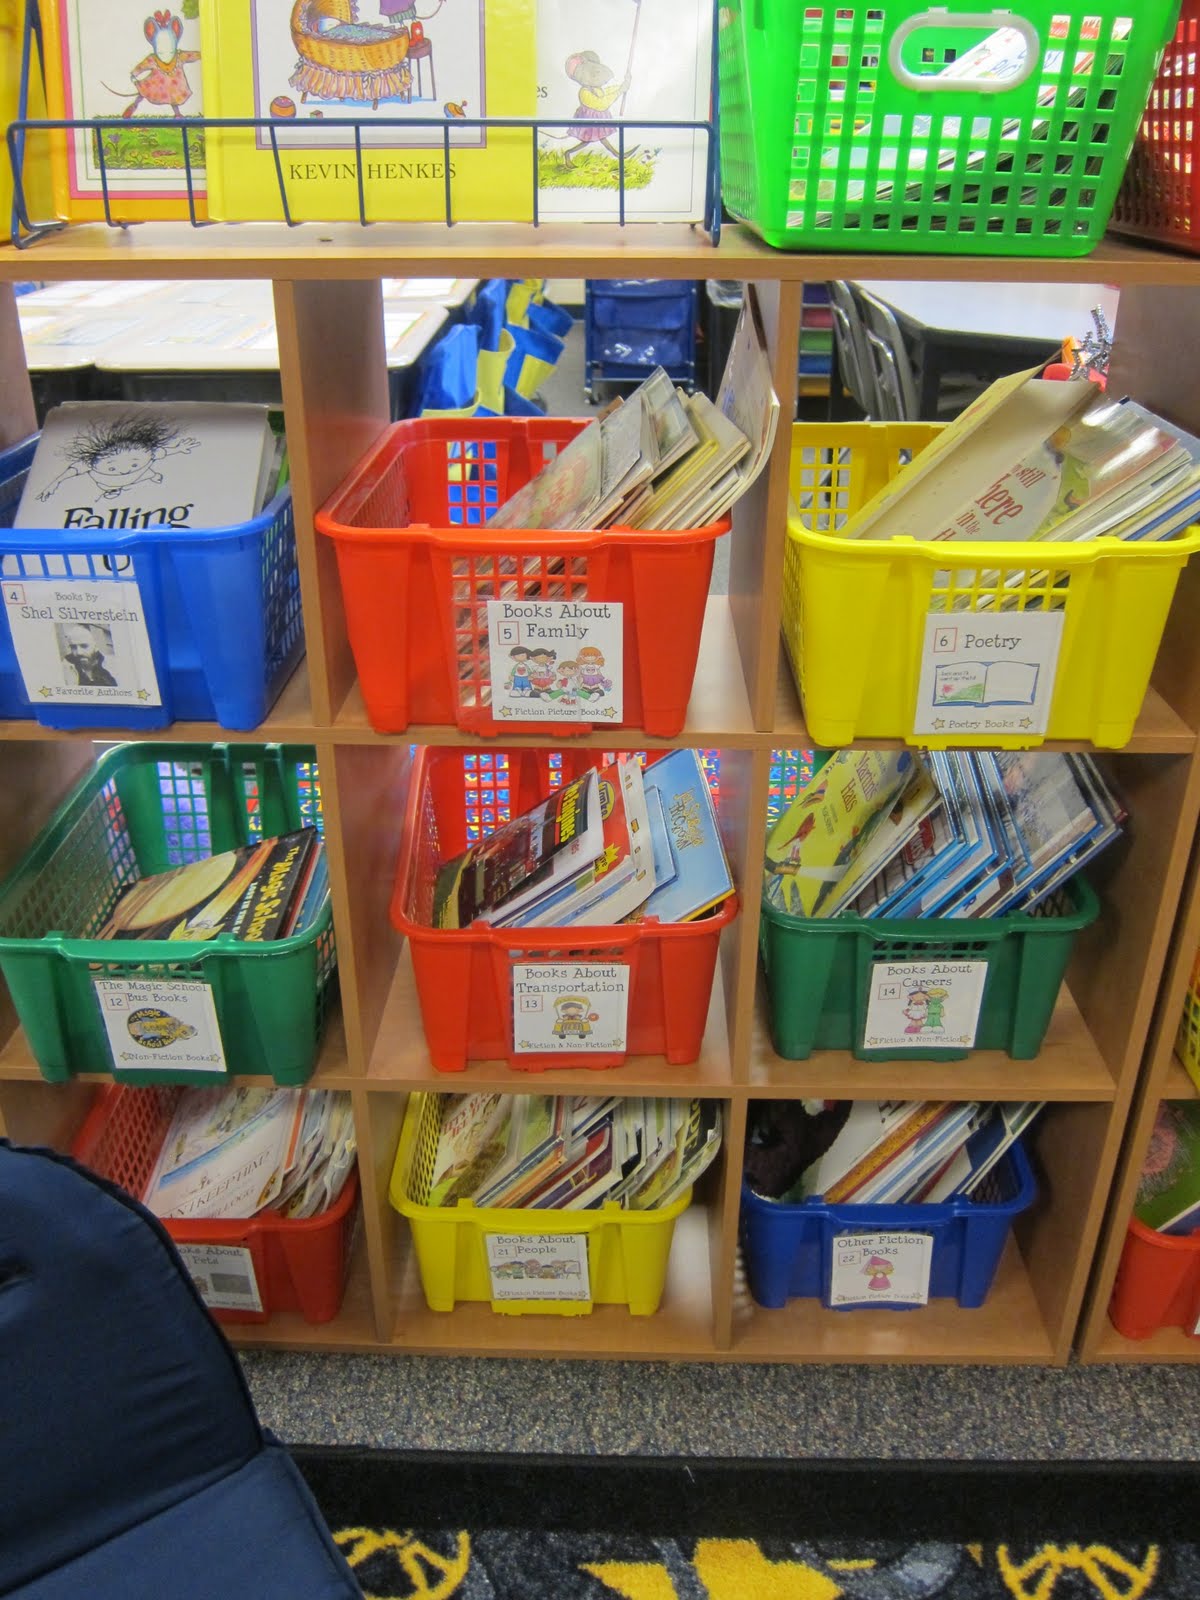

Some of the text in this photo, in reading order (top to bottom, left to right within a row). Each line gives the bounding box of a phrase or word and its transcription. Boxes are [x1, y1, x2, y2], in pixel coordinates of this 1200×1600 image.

[290, 163, 456, 180] KEVIN HENKES
[64, 503, 194, 529] Falling
[10, 591, 18, 602] 4
[54, 592, 99, 603] Books By
[21, 606, 139, 622] Shel Silverstein
[503, 604, 611, 619] Books About
[503, 624, 589, 640] 5 Family
[940, 634, 1021, 650] 6 Poetry
[55, 687, 133, 697] Favorite Authors
[515, 708, 606, 716] Fiction Picture Books
[948, 719, 1014, 729] Poetry Books
[841, 779, 858, 813] Hats
[285, 846, 300, 864] The
[259, 861, 291, 899] Magic
[525, 967, 617, 979] Books About
[887, 964, 972, 976] Books About
[100, 981, 208, 992] The Magic School
[516, 982, 625, 994] Transportation
[902, 978, 952, 988] Careers
[884, 988, 895, 996] 14
[110, 993, 188, 1006] 12 Bus Books
[525, 1000, 538, 1008] 13
[497, 1235, 576, 1244] Books About
[837, 1236, 924, 1248] Other Fiction
[205, 1246, 243, 1256] About
[517, 1246, 557, 1255] People
[863, 1247, 898, 1257] Books
[843, 1255, 855, 1263] 22
